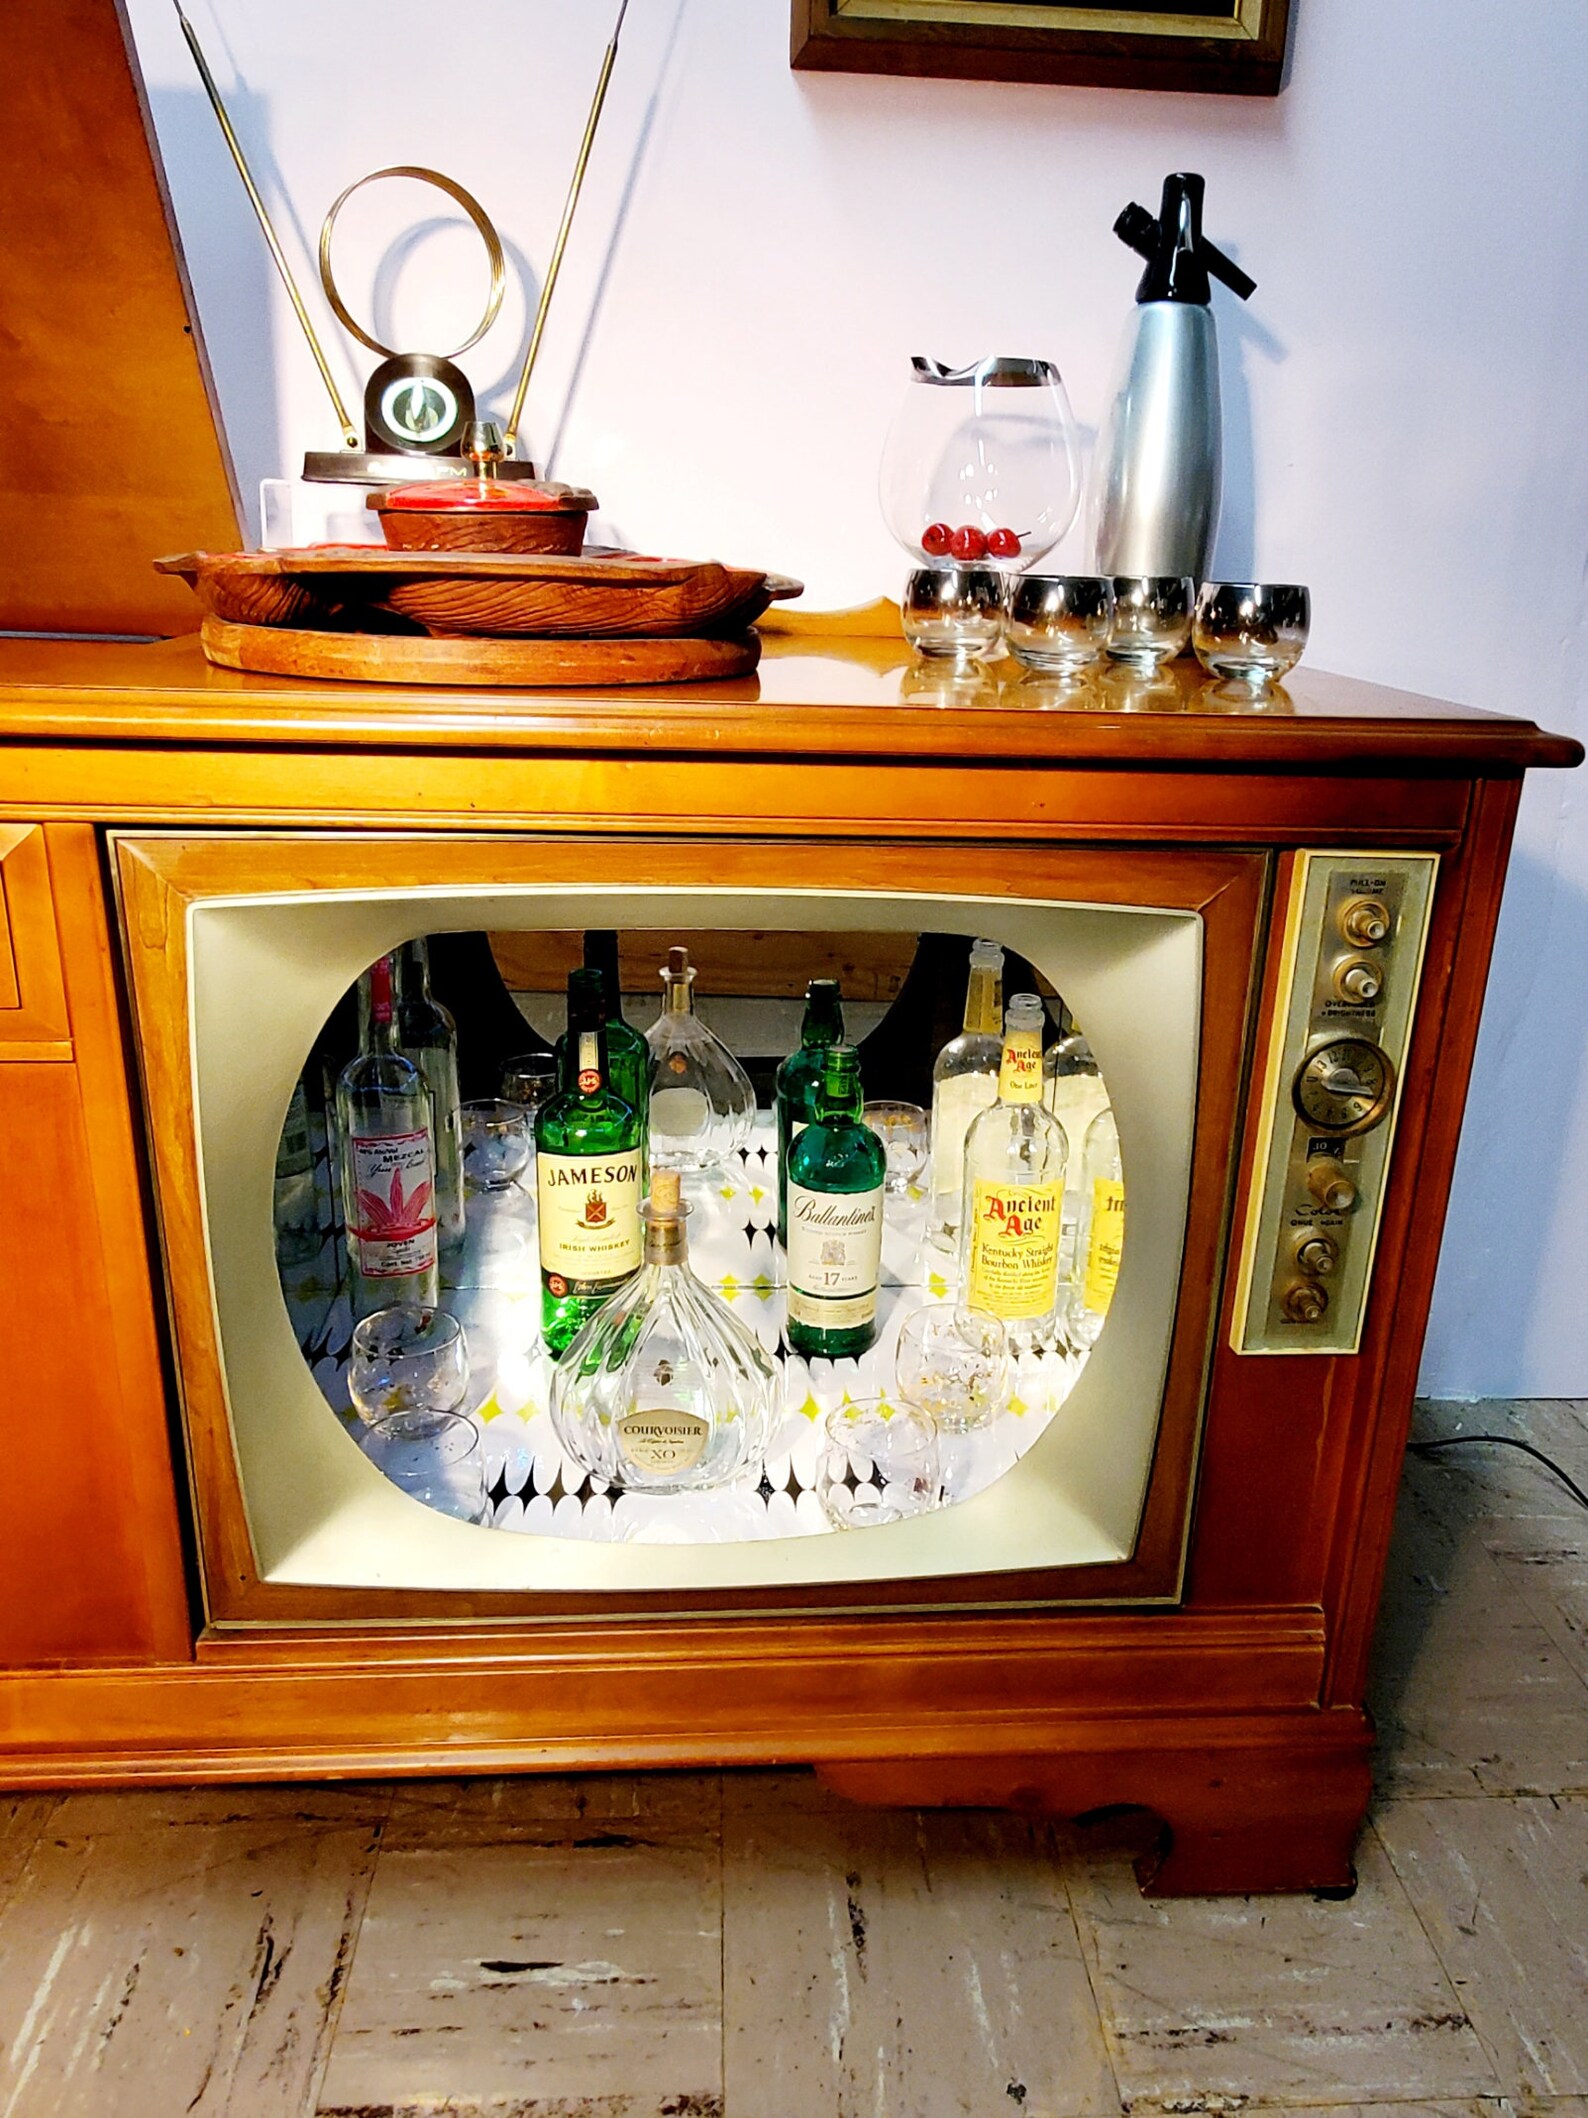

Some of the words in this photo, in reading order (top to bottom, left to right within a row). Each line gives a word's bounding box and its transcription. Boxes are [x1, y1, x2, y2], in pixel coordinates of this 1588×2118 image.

[1013, 1059, 1037, 1073] Age
[1313, 1059, 1328, 1073] 13
[382, 1148, 425, 1163] MEZCAL
[547, 1164, 638, 1188] JAMESON
[982, 1194, 1057, 1222] Ancient
[998, 1214, 1043, 1237] Age
[559, 1242, 586, 1252] IRISH
[589, 1238, 631, 1252] WHISKEY
[981, 1242, 1024, 1260] Kentucky
[981, 1254, 1020, 1270] Bourbon
[823, 1271, 841, 1286] 17
[623, 1425, 703, 1438] COURVOISIER
[650, 1449, 676, 1460] XO
